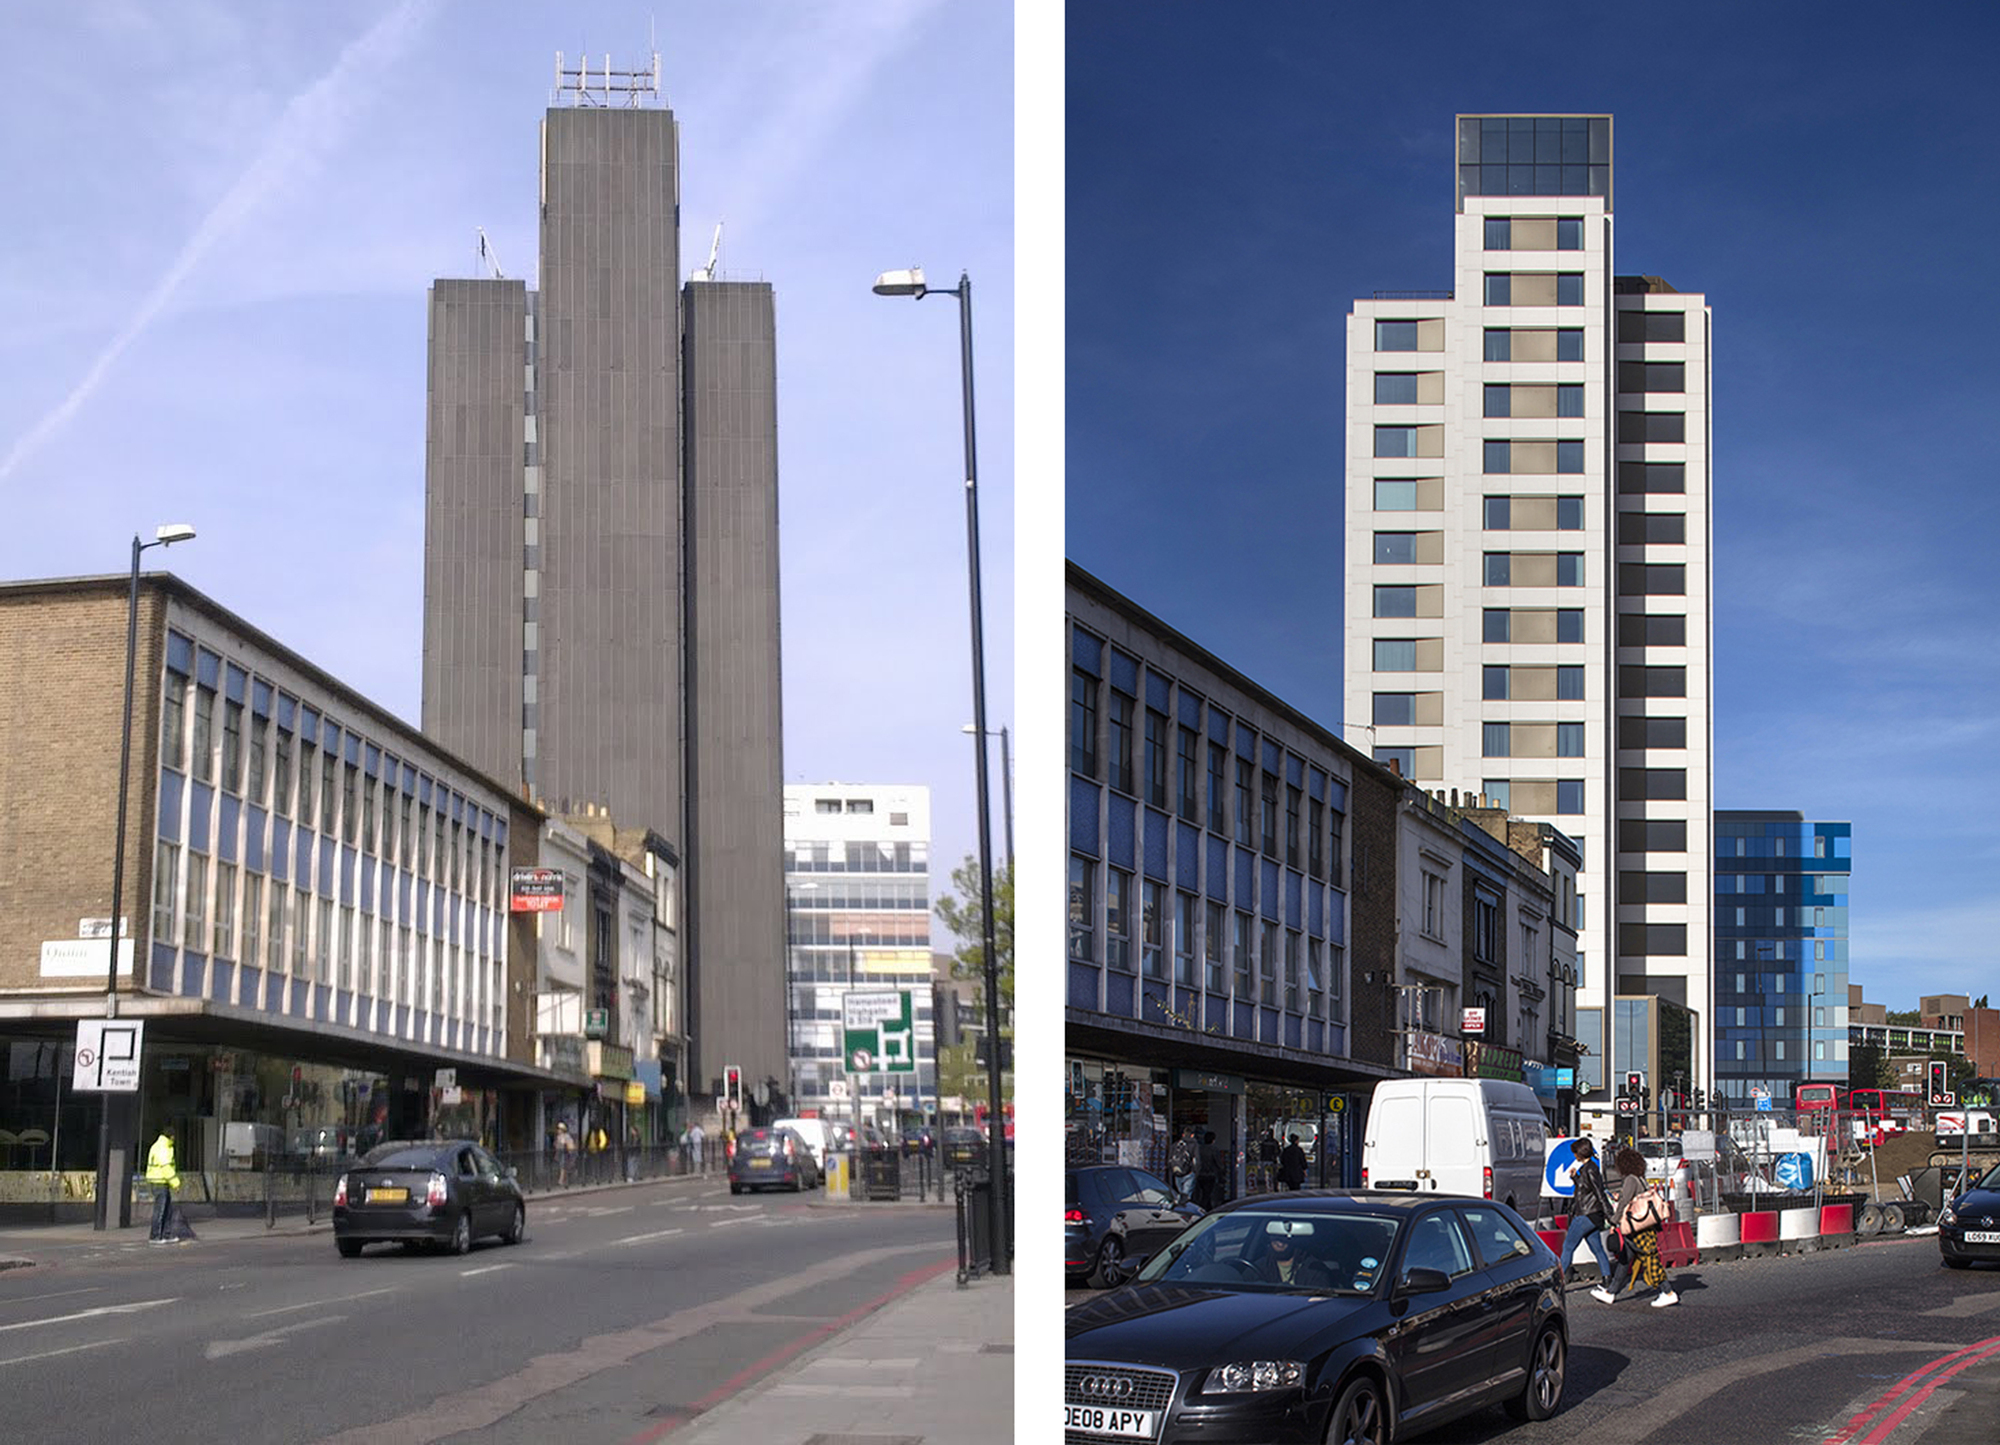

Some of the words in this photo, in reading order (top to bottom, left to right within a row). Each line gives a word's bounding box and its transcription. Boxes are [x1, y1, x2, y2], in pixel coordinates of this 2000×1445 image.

[1480, 1046, 1521, 1071] EXPRESS
[110, 1077, 132, 1087] Town
[1108, 1411, 1144, 1432] APY
